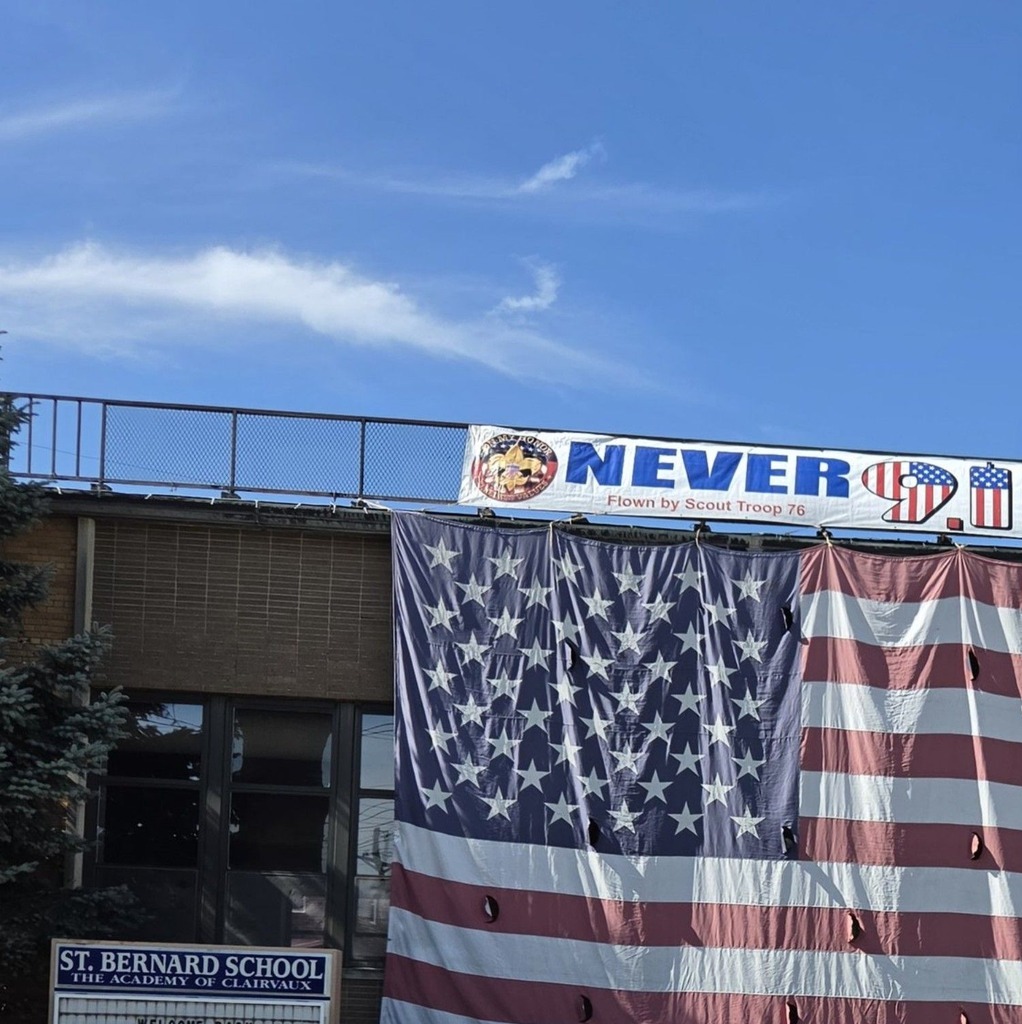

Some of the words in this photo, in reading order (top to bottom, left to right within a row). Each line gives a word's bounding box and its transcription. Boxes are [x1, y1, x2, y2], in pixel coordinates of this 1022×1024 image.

[498, 433, 516, 443] MY
[519, 435, 552, 456] HONOR
[565, 440, 850, 498] NEVER
[607, 494, 656, 509] Flown
[661, 497, 680, 512] by
[685, 498, 732, 512] Scout
[737, 500, 783, 517] Troop
[787, 503, 806, 516] 76
[60, 949, 94, 972] ST.
[100, 951, 220, 976] BERNARD
[225, 956, 324, 980] SCHOOL
[71, 972, 105, 983] THE
[110, 974, 189, 986] ACADEMY
[194, 976, 217, 988] OF
[221, 978, 312, 991] CLAIRVAUX
